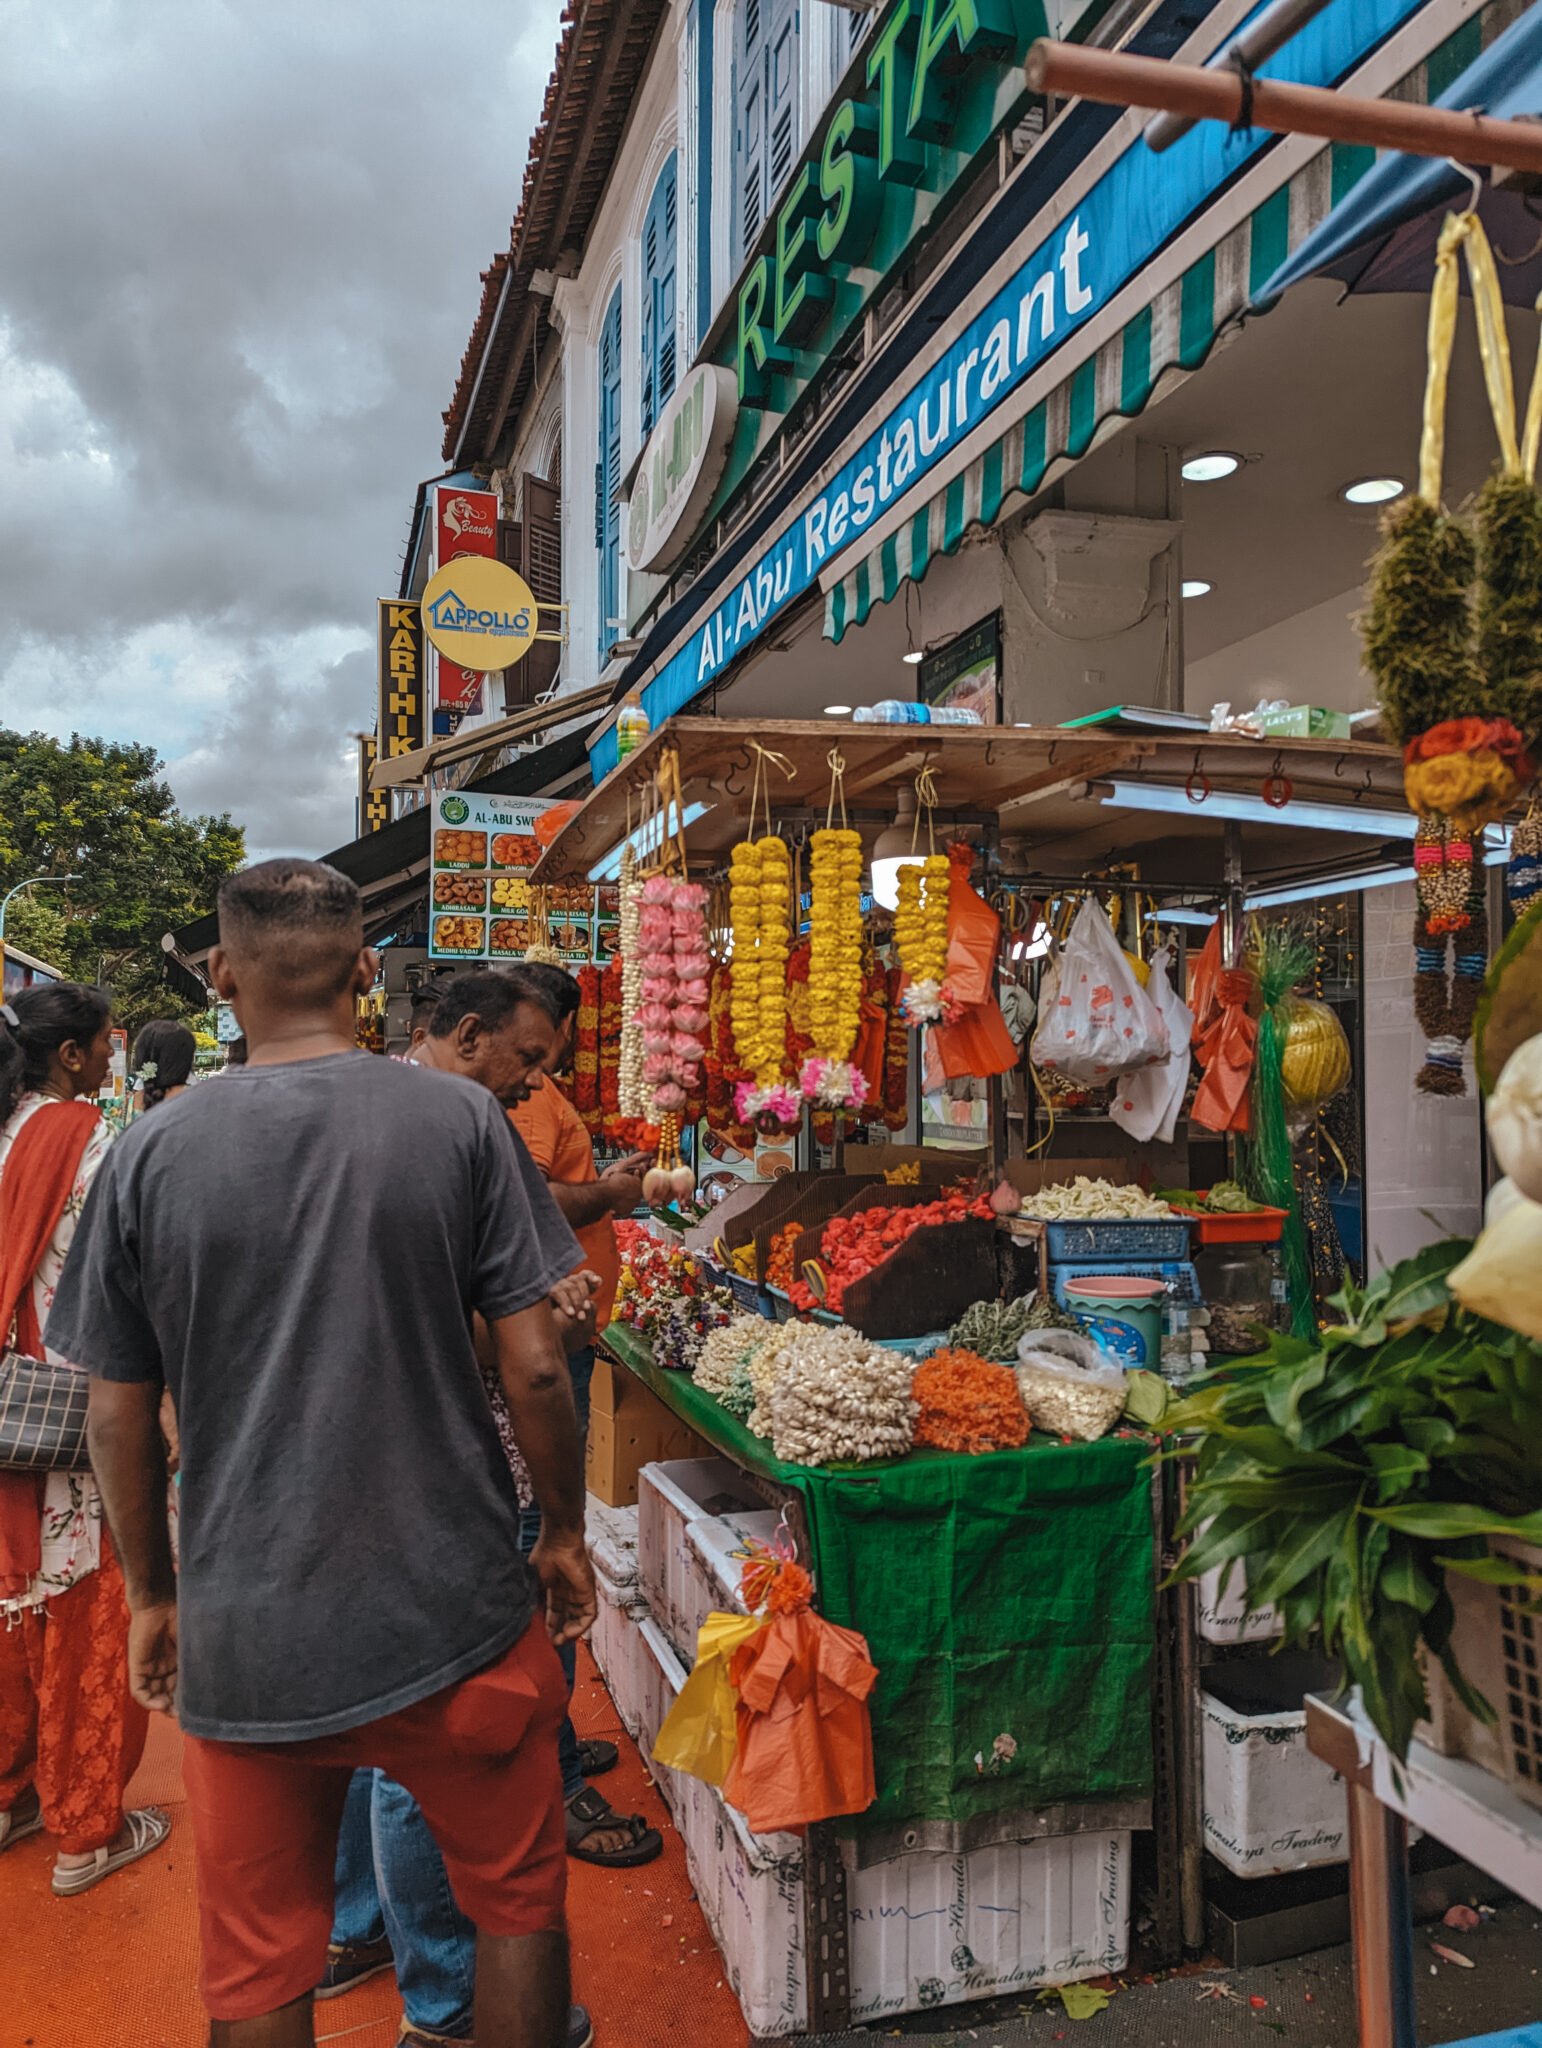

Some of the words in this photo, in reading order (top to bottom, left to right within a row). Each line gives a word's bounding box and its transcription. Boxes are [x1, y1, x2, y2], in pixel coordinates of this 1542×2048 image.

[696, 548, 794, 683] Al-Abu
[804, 214, 1094, 577] Restaurant
[461, 519, 494, 539] Beauty
[441, 606, 530, 631] APPOLLO
[474, 812, 513, 825] AL-ABU
[1271, 1829, 1343, 1852] Trading
[1100, 1839, 1121, 1925] Trading
[948, 1963, 1046, 1994] Himalaya
